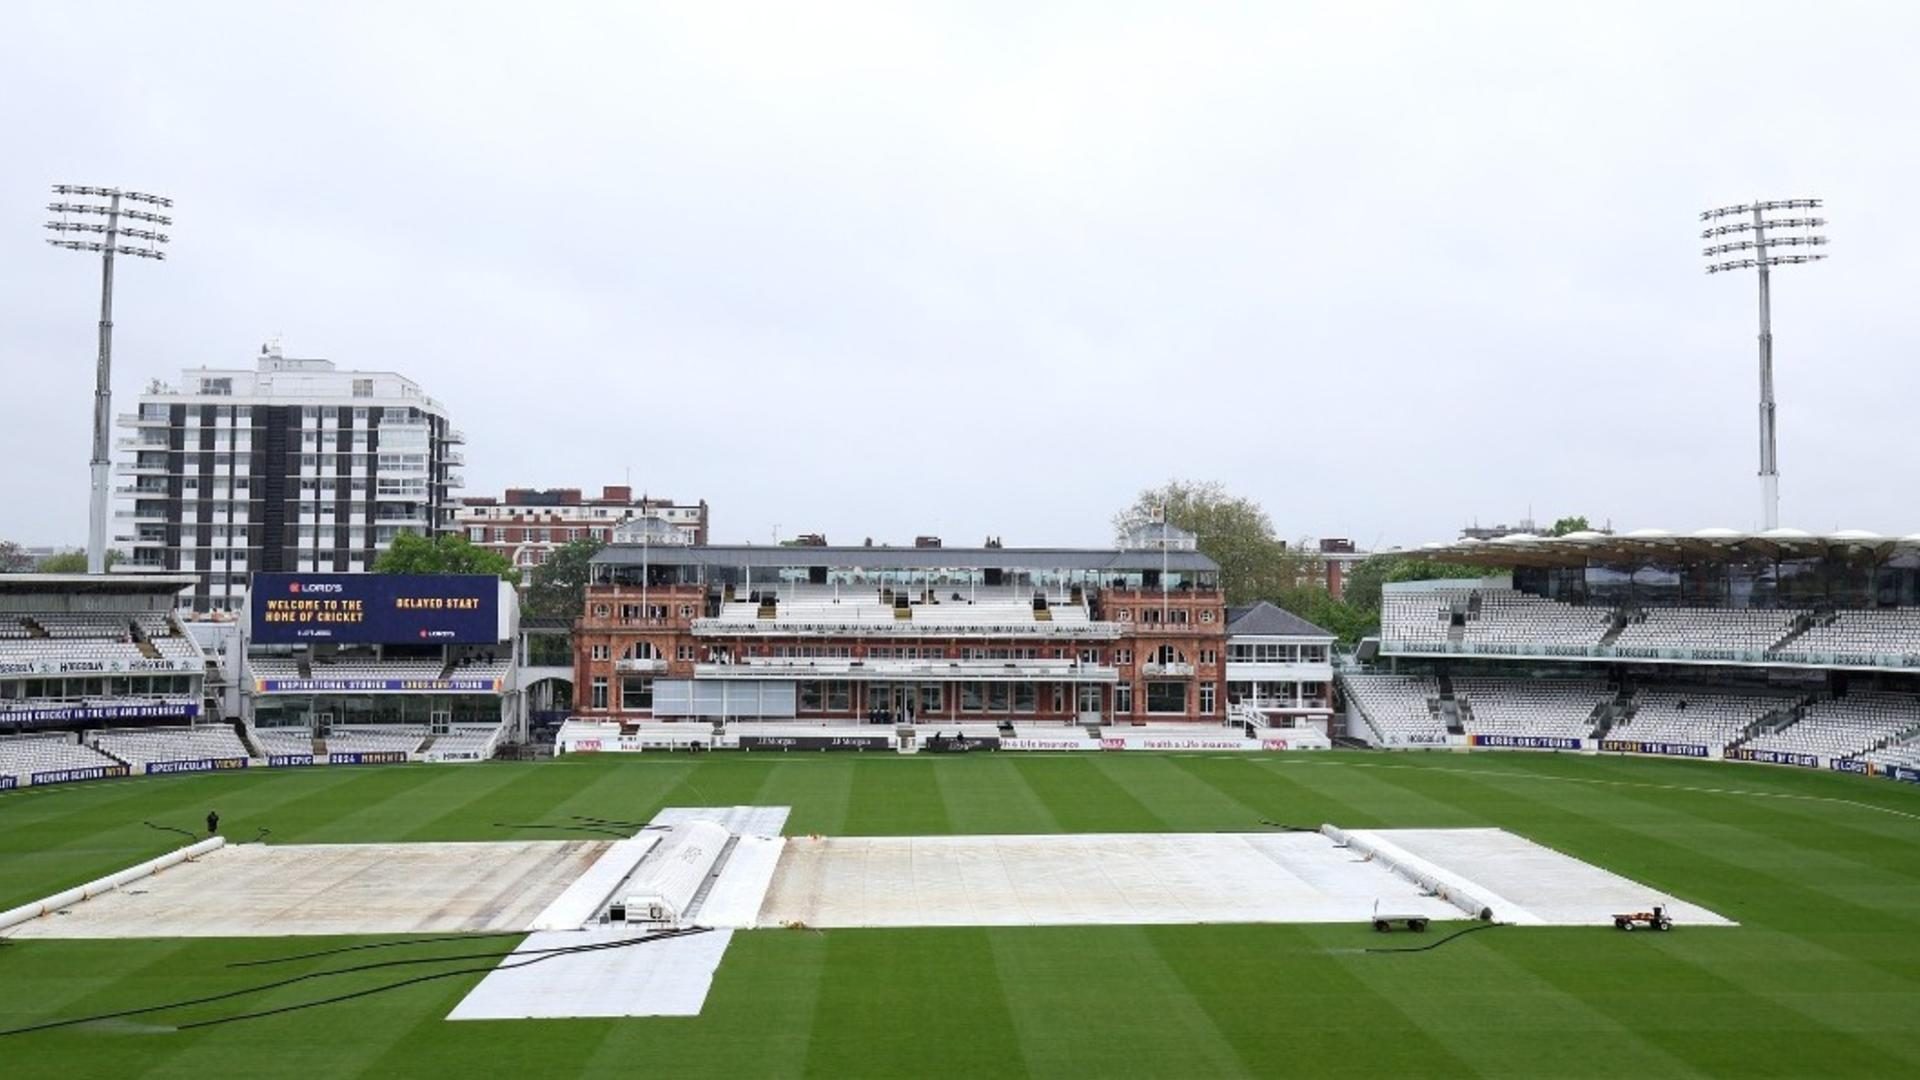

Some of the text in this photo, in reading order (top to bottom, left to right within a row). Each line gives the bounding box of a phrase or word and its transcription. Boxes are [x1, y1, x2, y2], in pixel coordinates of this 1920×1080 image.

[301, 583, 343, 593] LORD'S
[267, 600, 363, 610] WELCOME TO THE
[396, 598, 480, 609] DELAYED START
[265, 612, 363, 622] HOME OF CRICKET
[141, 705, 185, 716] OVERSEAS
[290, 756, 312, 765] EPIC
[151, 760, 213, 774] SPECTACULAR
[34, 771, 69, 784] PREMIUM
